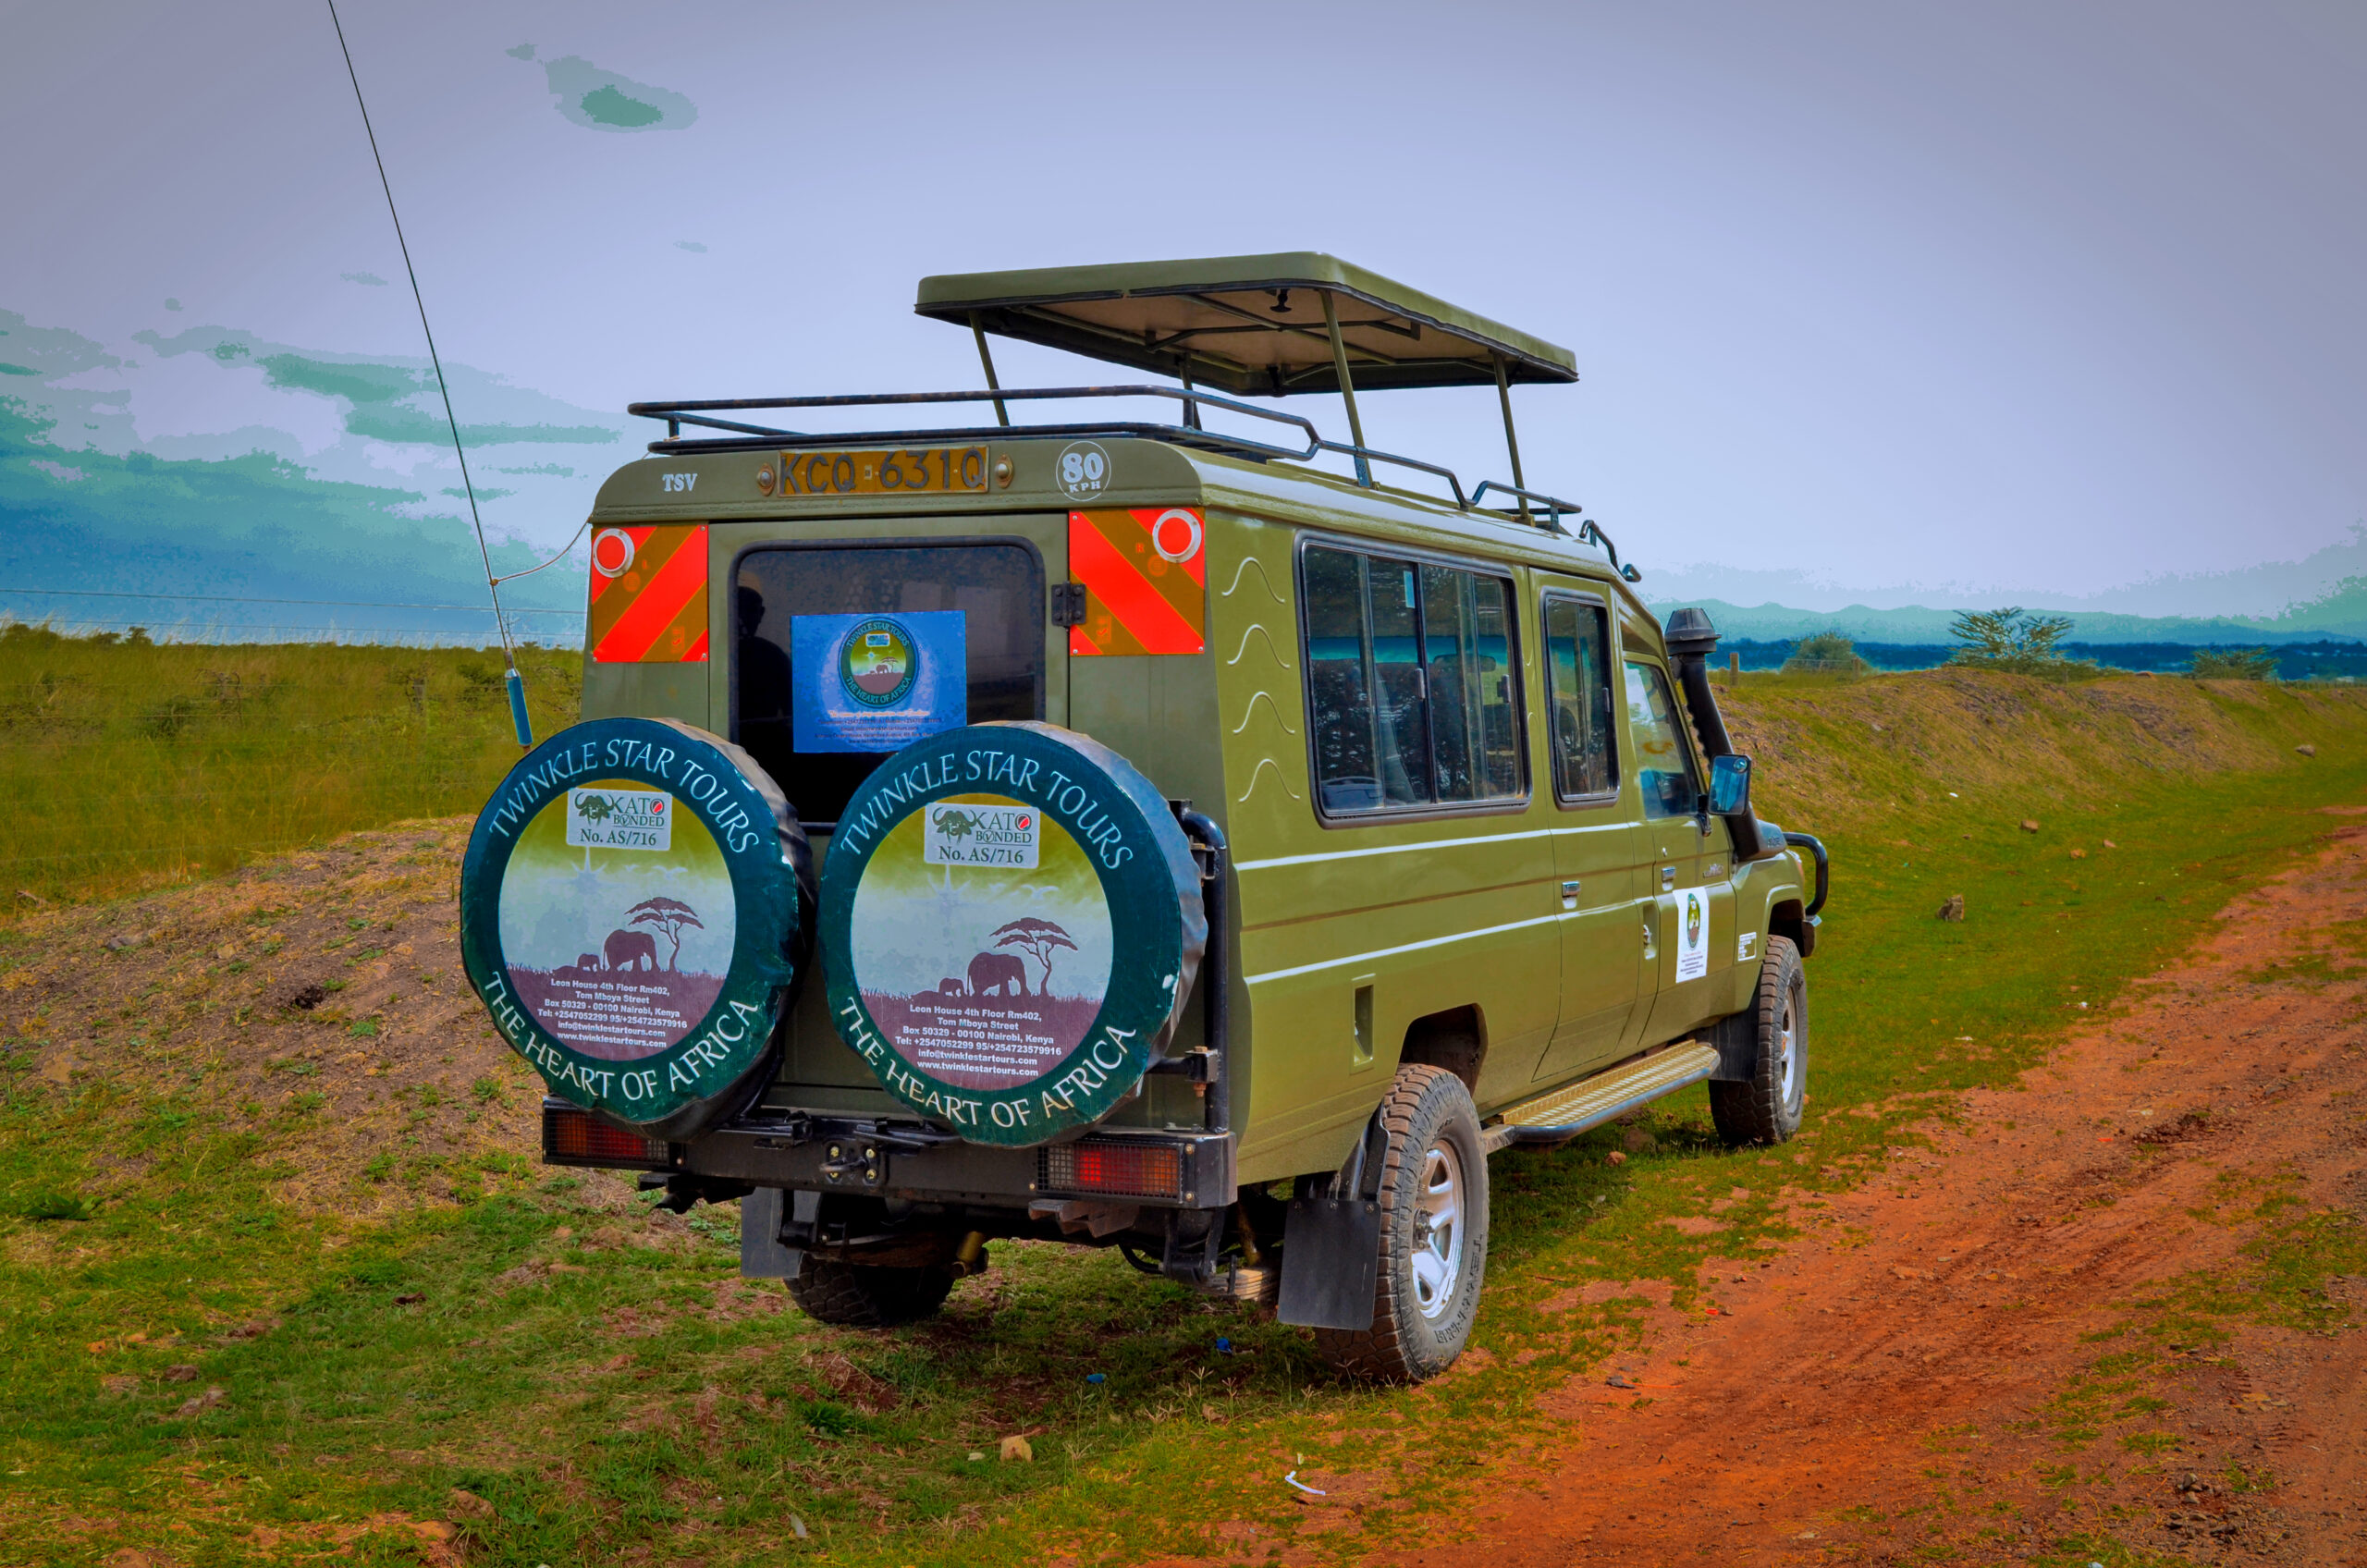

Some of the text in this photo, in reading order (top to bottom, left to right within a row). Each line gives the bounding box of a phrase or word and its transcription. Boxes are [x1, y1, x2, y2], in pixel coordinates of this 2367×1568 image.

[779, 448, 986, 495] KCQ 631Q
[1062, 452, 1104, 484] 80
[662, 472, 698, 492] TSV
[1069, 481, 1101, 493] KPH
[846, 623, 873, 647] TWINKLE
[873, 621, 890, 631] STAR
[889, 625, 910, 647] TOURS
[846, 676, 912, 704] THE HEART OF AFRICA
[488, 739, 759, 853] TWINKLE STAR TOURS
[610, 796, 665, 816] KATO
[840, 750, 1134, 869] TWINKLE STAR TOURS
[975, 812, 1032, 832] KATO
[580, 828, 656, 847] No. AS/716
[938, 845, 1024, 864] No. AS/716
[551, 978, 670, 997] Leon House 4th Floor Rm402,
[575, 990, 649, 1004] Tom Mboya Street
[537, 1009, 553, 1017] Tel:
[545, 998, 559, 1008] Box
[561, 1000, 586, 1009] 50329
[593, 1002, 618, 1012] 00100
[620, 1005, 653, 1016] Nairobi,
[655, 1008, 680, 1018] Kenya
[910, 1004, 1042, 1023] Leon House 4th Floor Rm402,
[938, 1017, 1019, 1031] Tom Mboya Street
[484, 971, 758, 1101] THE HEART OF AFRICA
[557, 1032, 667, 1047] www.twinklestartours.com
[895, 1036, 912, 1046] Tel:
[902, 1026, 919, 1035] Box
[922, 1027, 950, 1036] 50329
[957, 1029, 985, 1039] 00100
[987, 1031, 1024, 1044] Nairobi,
[1025, 1034, 1054, 1045] Kenya
[840, 997, 1136, 1127] THE HEART OF AFRICA
[918, 1049, 1037, 1065] info@twinklestartours.com
[917, 1061, 1038, 1076] www.twinklestartours.com
